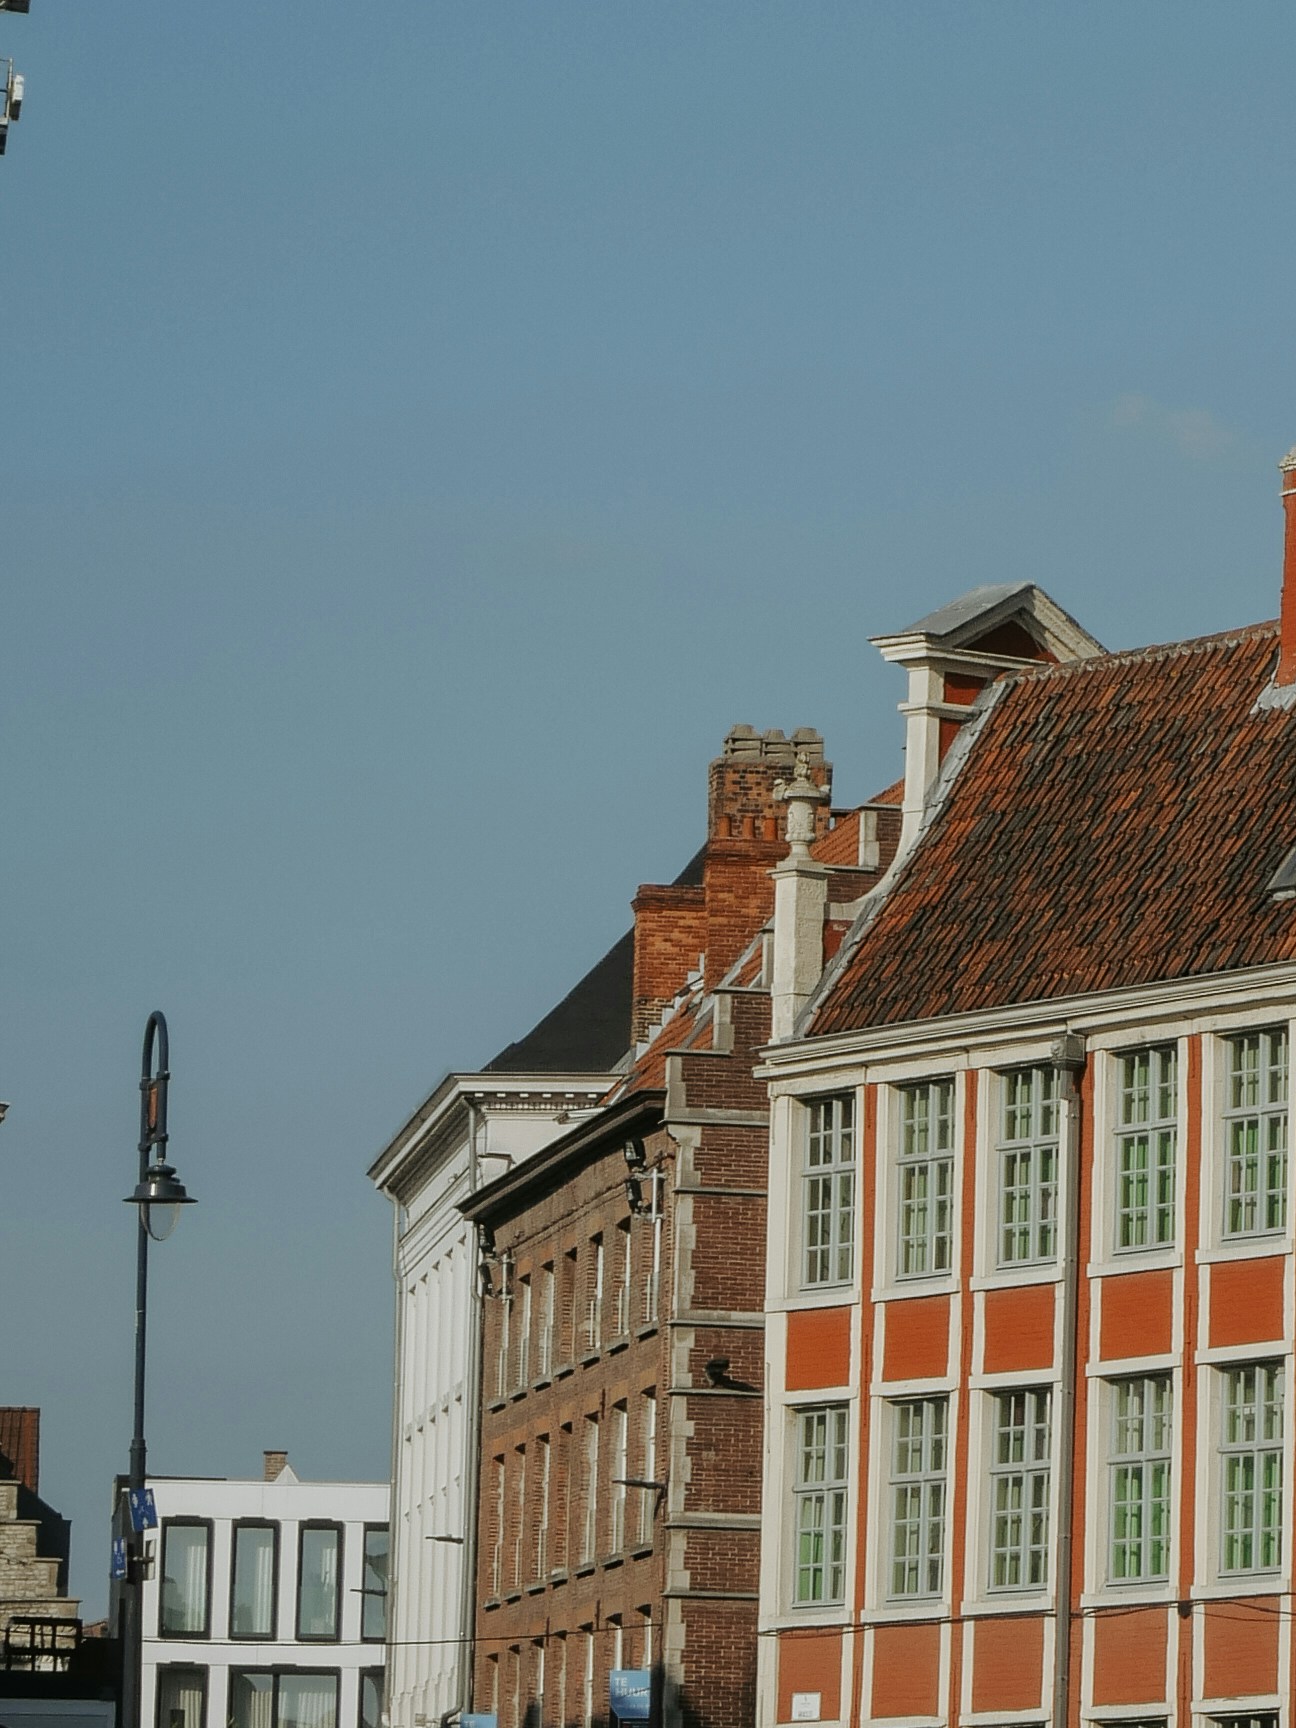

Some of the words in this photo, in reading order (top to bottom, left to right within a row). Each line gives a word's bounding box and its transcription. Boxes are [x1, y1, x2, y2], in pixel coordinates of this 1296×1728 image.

[615, 1677, 628, 1687] TE
[615, 1687, 649, 1698] HUUR
[464, 1720, 475, 1728] TE
